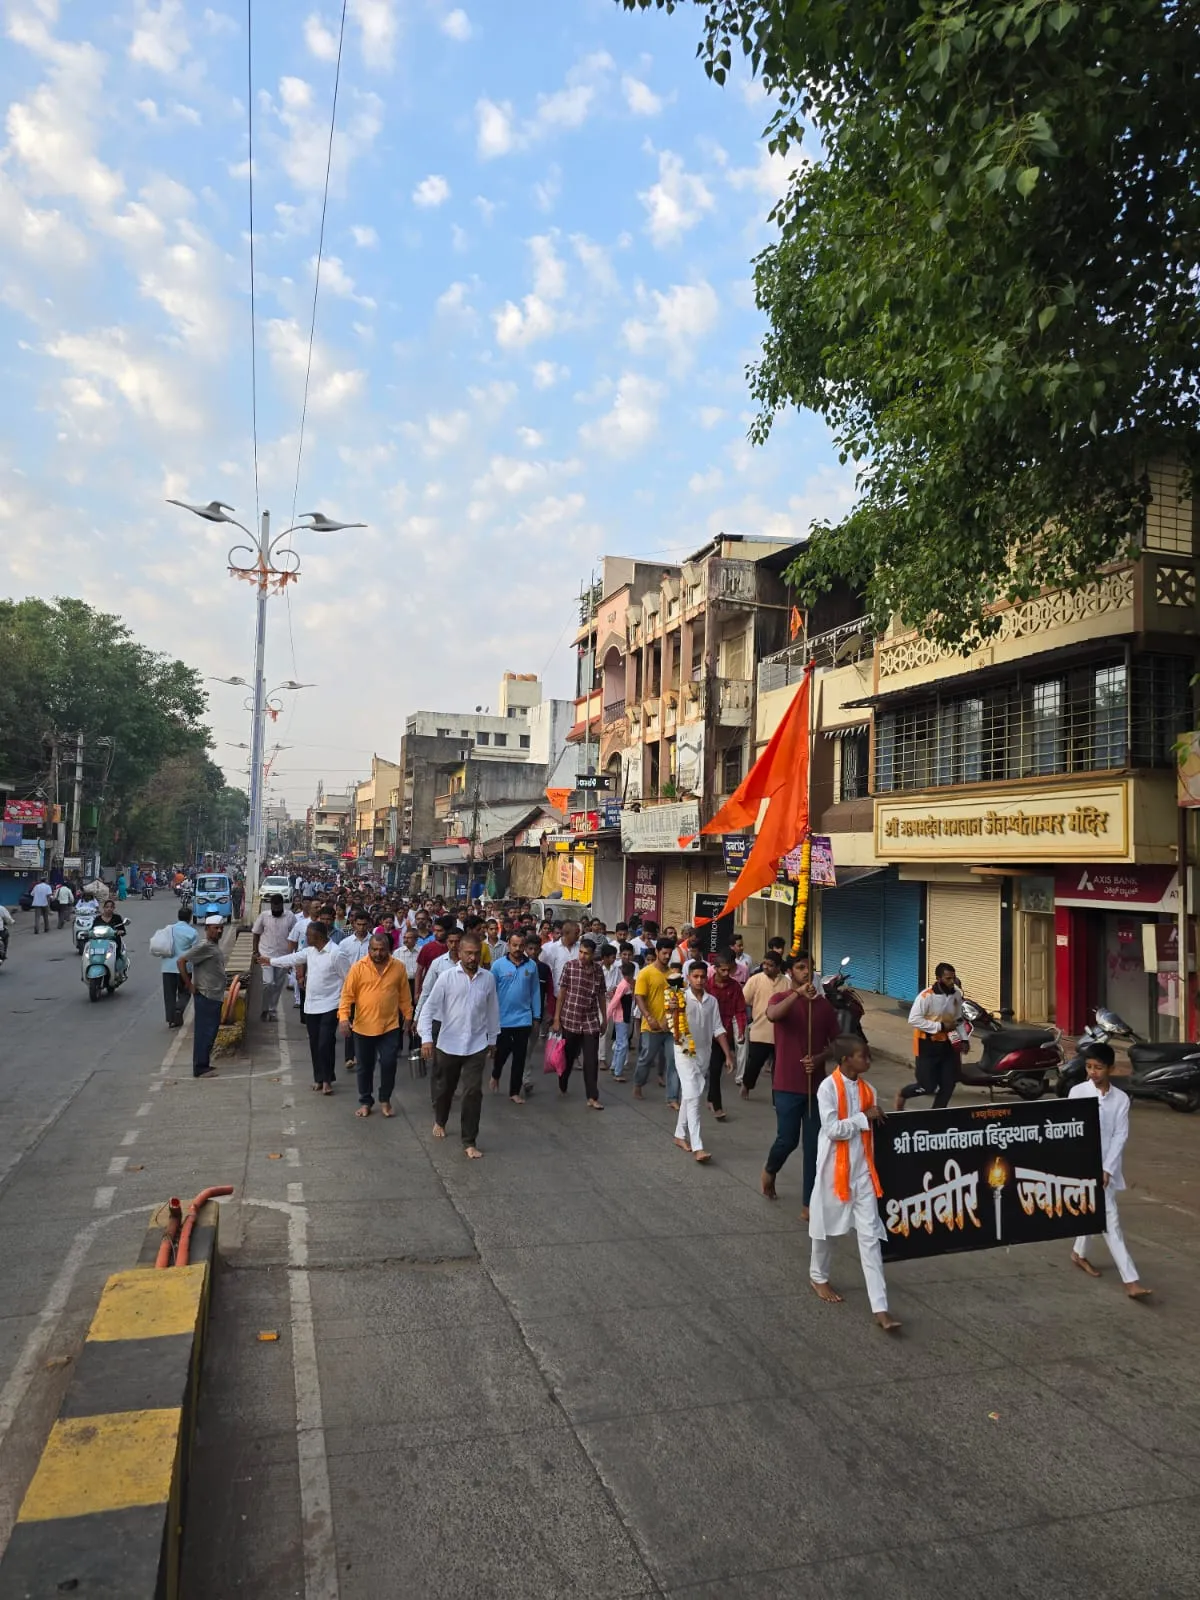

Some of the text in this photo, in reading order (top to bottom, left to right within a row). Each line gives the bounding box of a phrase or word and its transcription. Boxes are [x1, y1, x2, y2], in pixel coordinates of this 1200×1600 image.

[885, 816, 899, 838] श्री
[943, 816, 983, 837] भगवान
[1067, 805, 1110, 838] मंदिर
[1093, 875, 1112, 884] AXIS
[893, 1117, 1085, 1154] श्री शिवप्रतिष्ठान हिंदुस्थान, बेळगांव
[886, 1158, 1097, 1238] धर्मवीर ज्वाला
